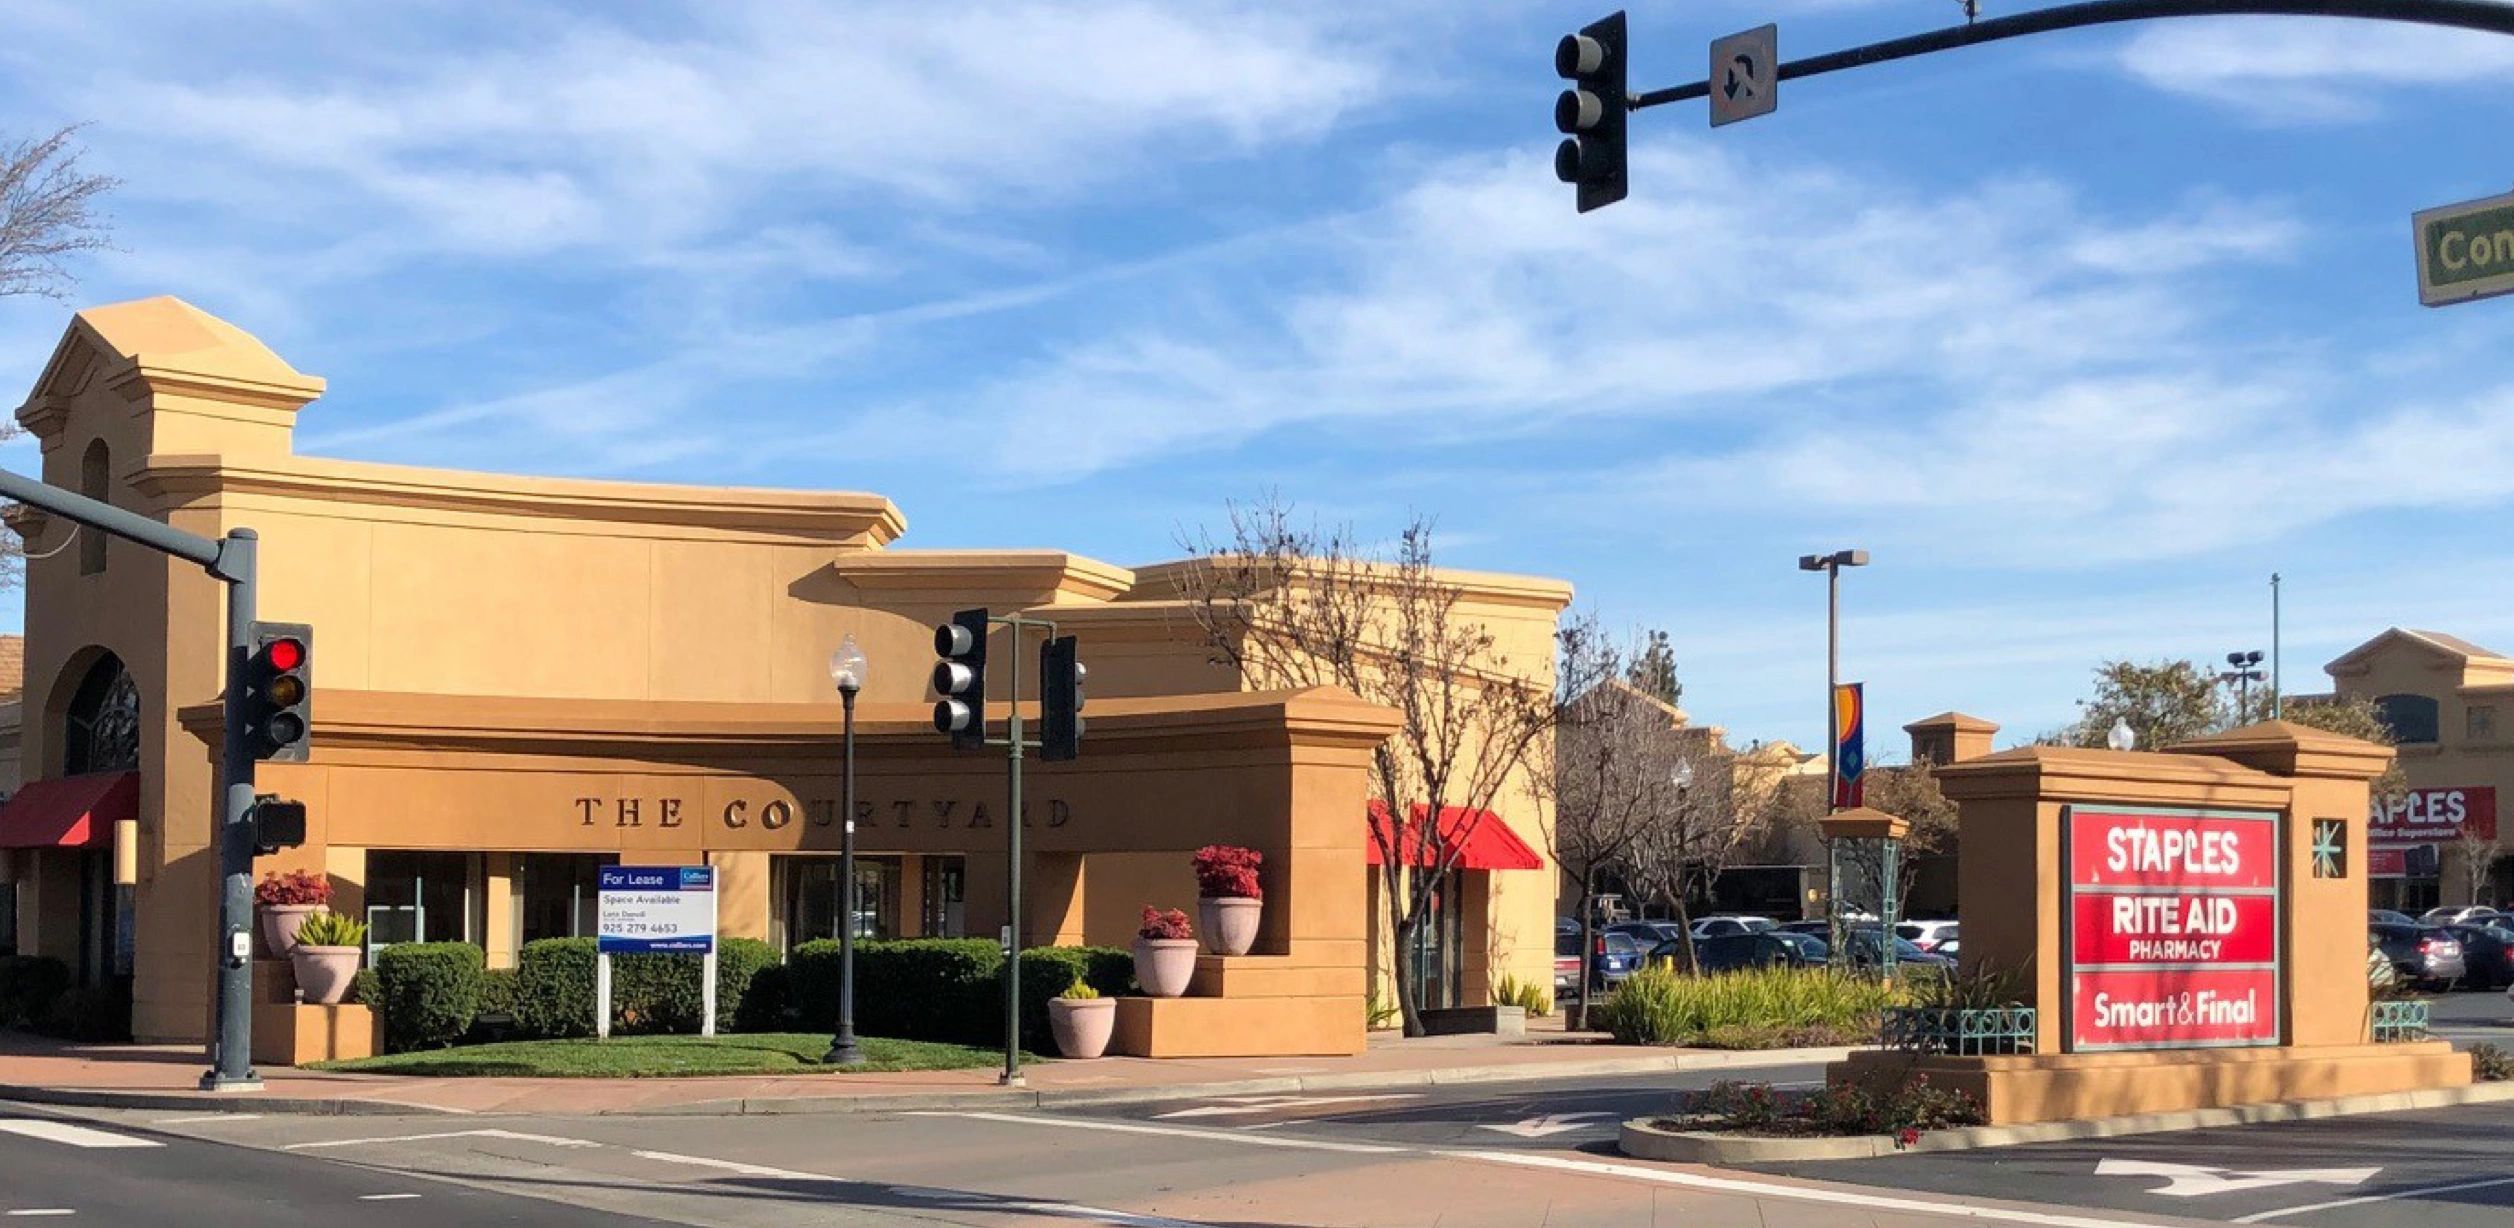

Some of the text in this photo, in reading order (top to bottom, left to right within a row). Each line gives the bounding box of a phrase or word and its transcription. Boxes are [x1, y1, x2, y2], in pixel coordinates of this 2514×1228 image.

[575, 798, 683, 828] THE
[2368, 790, 2466, 823] APLES
[2107, 826, 2240, 875] STAPLES
[603, 872, 664, 885] For Lease
[603, 895, 680, 906] Space Available
[2112, 896, 2237, 935] RITE AID
[603, 924, 623, 933] 925
[626, 924, 646, 933] 279
[2129, 939, 2222, 960] PHARMACY
